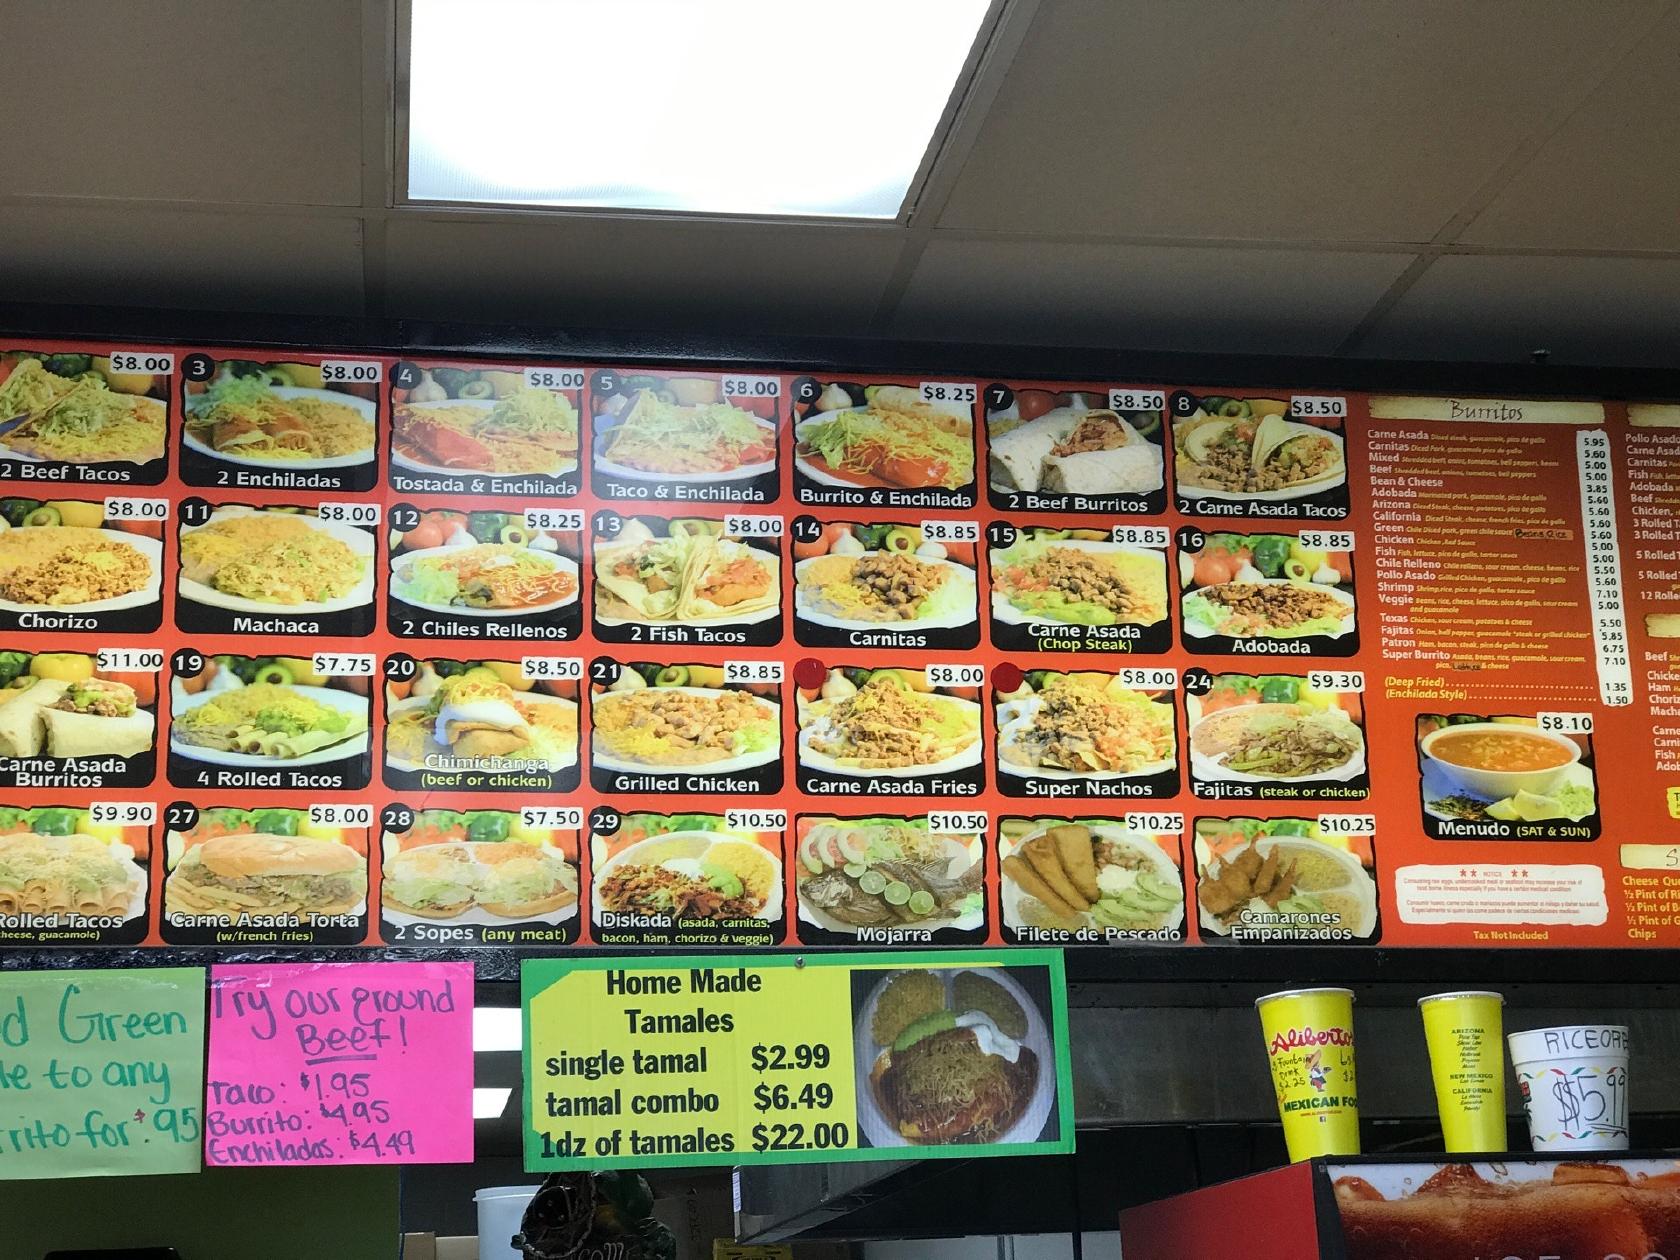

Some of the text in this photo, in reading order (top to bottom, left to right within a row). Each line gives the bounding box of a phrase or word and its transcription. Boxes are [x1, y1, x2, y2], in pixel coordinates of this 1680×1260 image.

[322, 364, 378, 380] $8.00
[923, 385, 976, 402] $8.25
[1113, 393, 1164, 410] $8.50
[1450, 400, 1522, 421] Burritos
[1369, 453, 1400, 463] Mixed
[1, 464, 130, 482] 2 Beef Tacos
[217, 471, 341, 489] 2 Enchiladas
[394, 476, 577, 496] Tostada & Enchilada
[1370, 476, 1443, 487] Bean & Cheese
[1586, 484, 1608, 494] 3.85
[607, 483, 764, 502] Taco & Enchilada
[800, 489, 972, 508] Burrito & Enchilada
[1009, 495, 1148, 512] 2 Beef Burritos
[1179, 500, 1346, 518] 2 Carne Asada Tacos
[184, 505, 208, 520] 11
[320, 506, 376, 522] $8.00
[1373, 512, 1421, 522] California
[924, 524, 976, 541] $8.85
[1376, 558, 1441, 569] Chile Relleno
[1378, 582, 1414, 594] Shrimp
[18, 613, 98, 630] Chorizo
[234, 618, 319, 634] Machaca
[402, 620, 568, 639] 2 Chiles Rellenos
[630, 626, 746, 644] 2 Fish Tacos
[850, 631, 926, 647] Carnitas
[1028, 623, 1141, 639] Carne Asada
[1038, 637, 1132, 652] (Chop Steak)
[1232, 640, 1310, 654] Adobada
[1382, 638, 1415, 647] Patron
[98, 653, 163, 668] $11.00
[176, 656, 201, 670] 19
[315, 657, 371, 673] $7.75
[930, 668, 984, 683] $8.00
[1384, 676, 1444, 688] (Deep Fried)
[1386, 689, 1467, 700] (Enchilada Style)
[1542, 717, 1592, 731] $8.10
[0, 758, 126, 774] Carne Asada
[424, 754, 548, 774] Chimichanga
[16, 771, 102, 787] Burritos
[198, 772, 342, 788] 4 Rolled Tacos
[421, 773, 552, 788] (beef or chicken)
[615, 776, 760, 793] Grilled Chicken
[807, 779, 977, 794] Carne Asada Fries
[1025, 780, 1152, 798] Super Nachos
[1194, 783, 1370, 800] Fajitas (steak or chicken)
[1438, 822, 1590, 838] Menudo (SAT & SUN)
[1622, 877, 1658, 886] Cheese
[0, 913, 123, 928] Rolled Tacos
[171, 912, 359, 929] Carne Asada Torta
[602, 912, 770, 930] Diskada (asada, carnitas,
[1240, 911, 1340, 924] Camarones
[39, 930, 100, 942] guacamole)
[216, 930, 313, 942] (w/french fries)
[395, 925, 566, 944] 2 Sopes (any meat)
[602, 932, 773, 946] bacon, ham, chorizo & veggie)
[857, 927, 932, 944] Mojarra
[1016, 927, 1180, 942] Filete de Pescado
[1231, 926, 1352, 942] Empanizados
[1473, 931, 1548, 940] Tax Not Included
[1628, 929, 1656, 938] Chips
[607, 969, 762, 996] Home Made
[59, 984, 186, 1044] Green
[211, 977, 454, 1040] Try our ground
[624, 1008, 734, 1034] Tamales
[296, 1017, 408, 1056] Beef!
[546, 1044, 830, 1078] single tamal $2.99
[43, 1059, 92, 1088] to
[103, 1062, 170, 1104] any
[301, 1072, 370, 1099] $1.95
[546, 1083, 833, 1117] tamal combo $6.49
[1284, 1097, 1338, 1112] MEXICAN
[208, 1101, 390, 1138] Burrito: $4.95
[76, 1110, 128, 1148] for
[209, 1129, 414, 1164] Enchiladas: $4.49
[541, 1122, 848, 1158] 1dz of tamales $22.00
